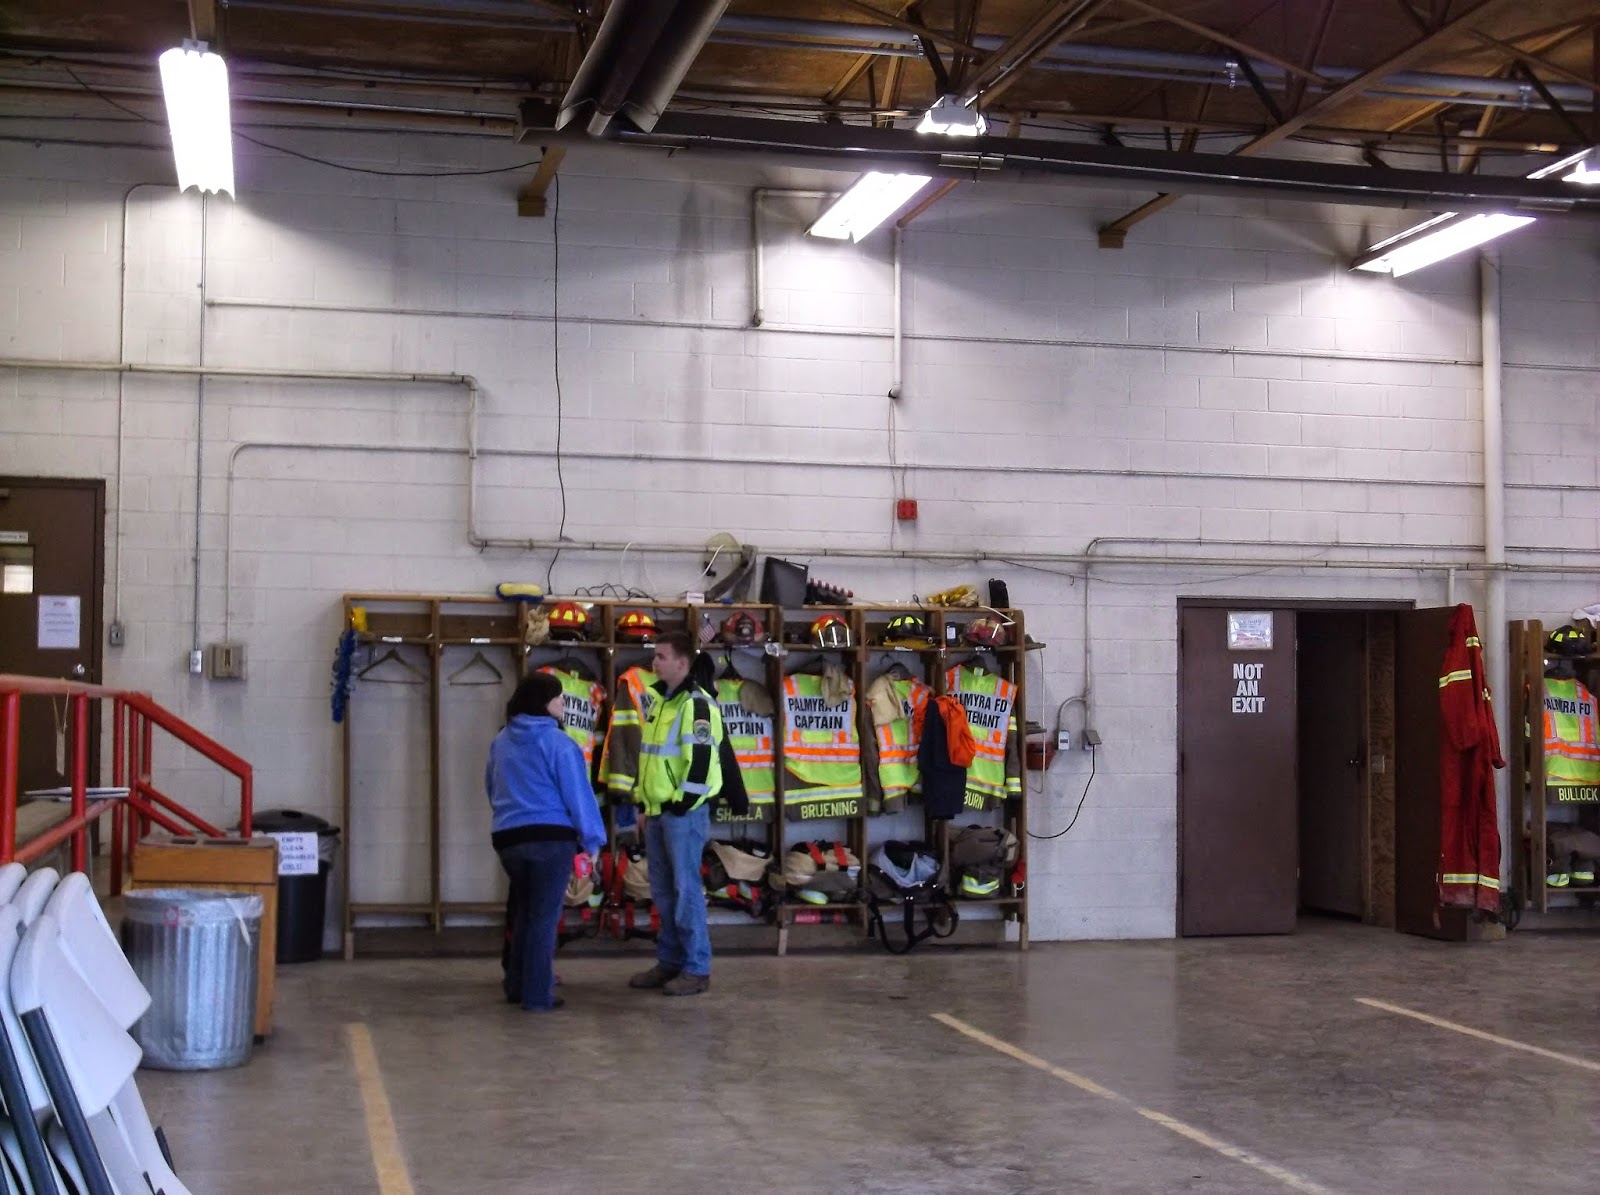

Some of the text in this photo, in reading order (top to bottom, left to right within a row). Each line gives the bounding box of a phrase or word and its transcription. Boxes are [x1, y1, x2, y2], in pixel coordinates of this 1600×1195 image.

[1233, 663, 1264, 680] NOT
[1236, 680, 1259, 696] AN
[788, 697, 832, 712] PALMYR
[994, 698, 1008, 713] FD
[1232, 697, 1266, 713] EXIT
[1579, 702, 1592, 716] FD
[794, 715, 843, 730] CAPTAIN
[965, 710, 1000, 729] TENANT
[1558, 787, 1598, 801] BULLOCK
[801, 800, 858, 819] BRUENING
